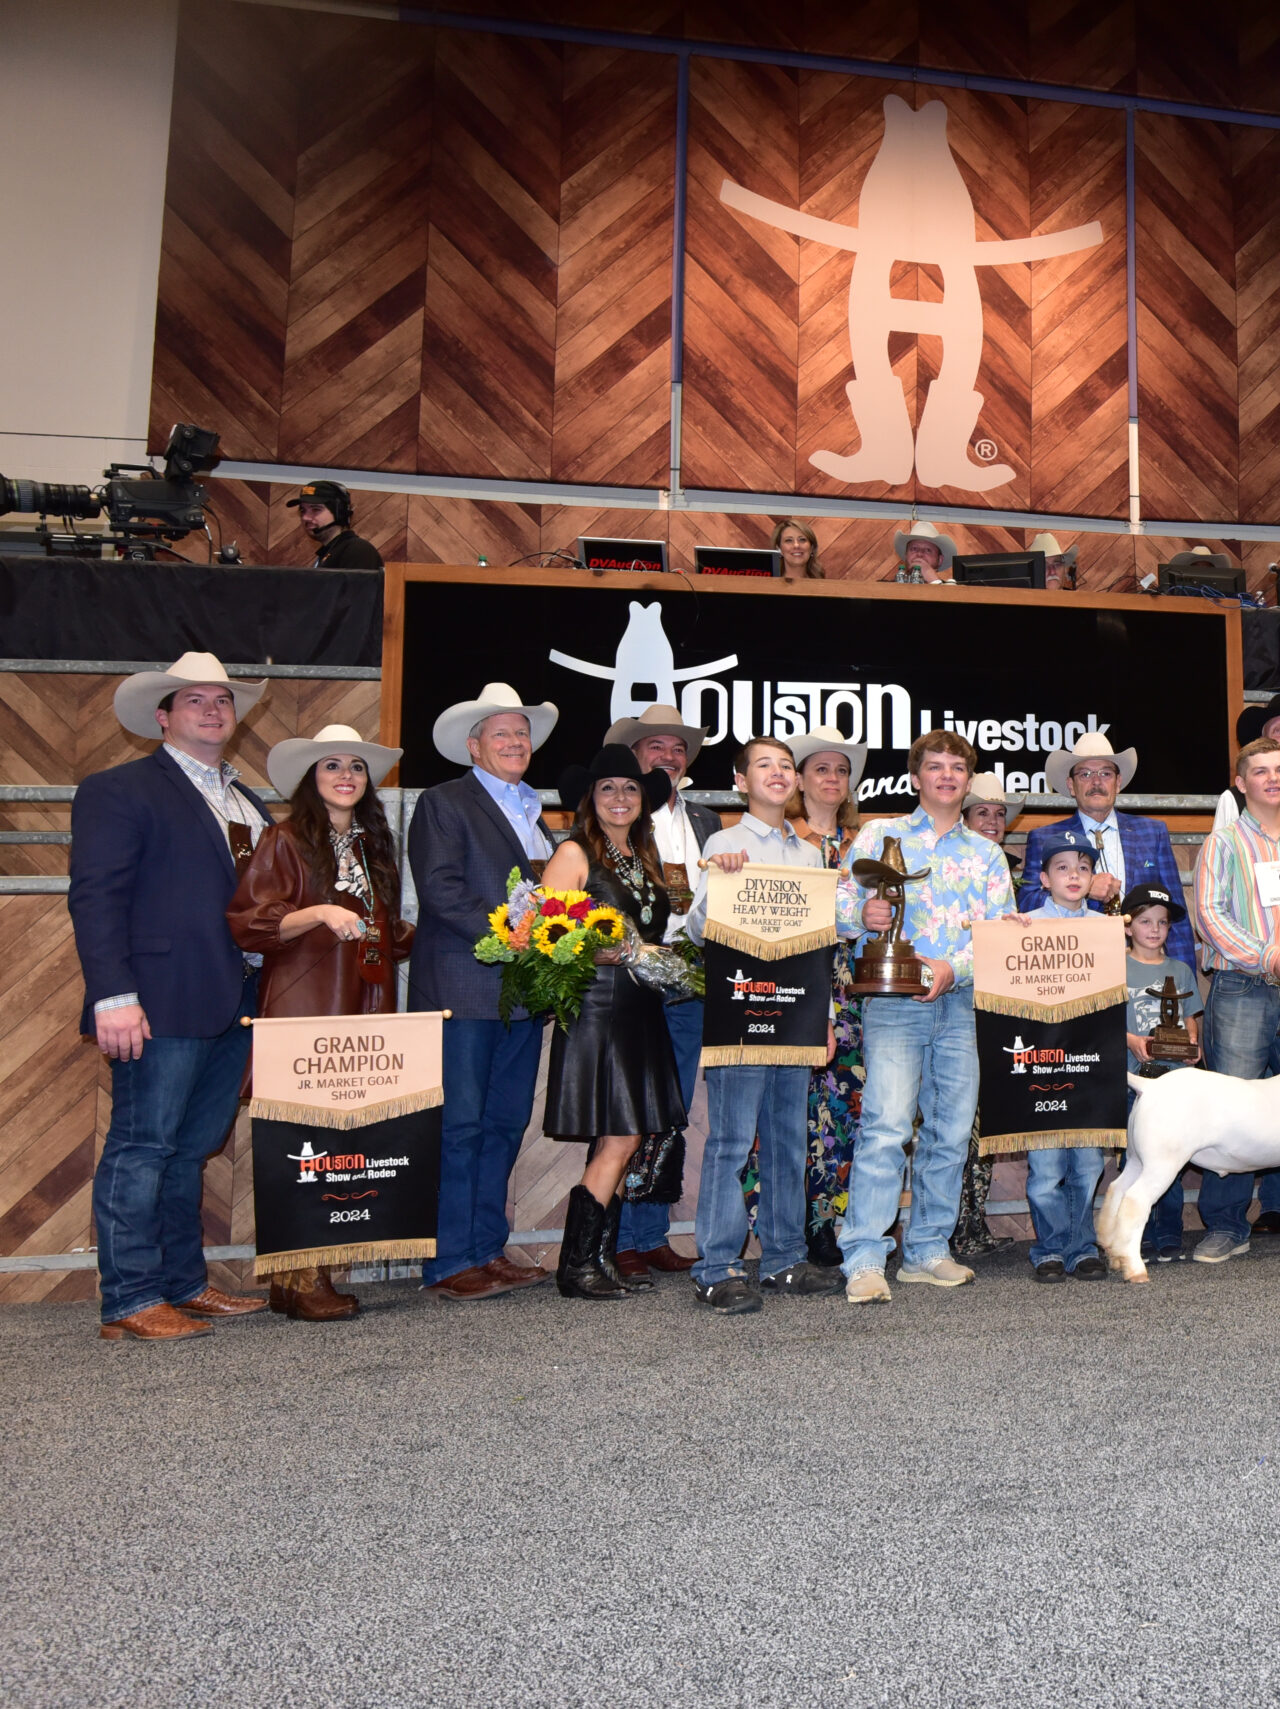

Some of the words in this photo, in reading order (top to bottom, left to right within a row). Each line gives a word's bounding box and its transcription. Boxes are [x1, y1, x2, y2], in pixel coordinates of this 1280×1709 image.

[589, 558, 661, 570] DVAuction
[745, 879, 802, 892] DIVISION
[737, 891, 808, 905] CHAMPION
[733, 904, 768, 916] HEAVY
[770, 906, 811, 917] WEIGHT
[752, 918, 782, 926] MARKET
[784, 919, 803, 927] GOAT
[1021, 935, 1078, 952] GRAND
[1006, 952, 1095, 971] CHAMPION
[1010, 975, 1022, 985] JR.
[1025, 974, 1063, 984] MARKET
[1066, 973, 1092, 983] GOAT
[776, 984, 805, 995] Livestock
[1037, 986, 1066, 996] SHOW
[776, 995, 796, 1003] Rodeo
[748, 1024, 775, 1033] 2024
[314, 1035, 385, 1054] GRAND
[1065, 1052, 1100, 1063] Livestock
[293, 1054, 404, 1075] CHAMPION
[1032, 1064, 1052, 1074] Show
[1066, 1064, 1089, 1073] Rodeo
[298, 1079, 313, 1090] JR.
[317, 1077, 365, 1089] MARKET
[368, 1075, 399, 1086] GOAT
[331, 1090, 366, 1101] SHOW
[1035, 1100, 1067, 1112] 2024
[366, 1155, 409, 1168] Livestock
[326, 1172, 350, 1182] Show
[368, 1168, 396, 1179] Rodeo
[330, 1209, 371, 1224] 2024
